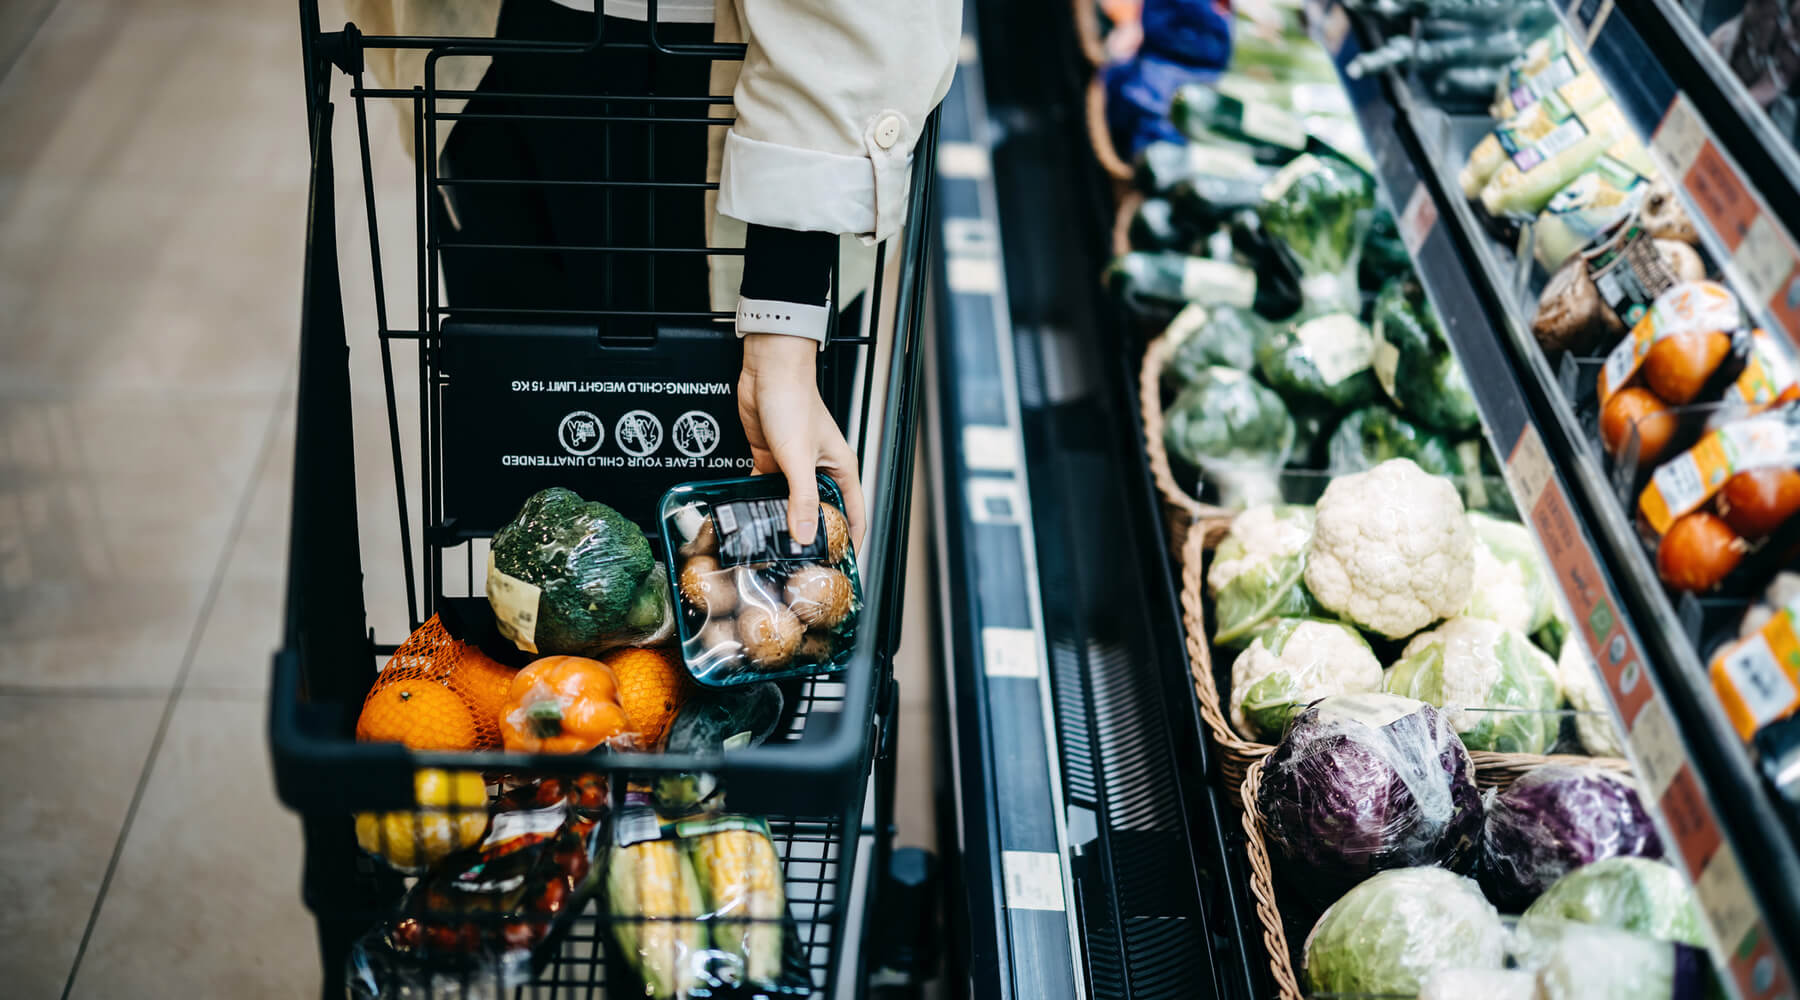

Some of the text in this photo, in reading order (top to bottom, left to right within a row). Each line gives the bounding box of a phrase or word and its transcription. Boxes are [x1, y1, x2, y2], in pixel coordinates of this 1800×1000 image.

[511, 381, 530, 391] KG
[532, 381, 545, 391] 15
[546, 381, 577, 392] LIMIT
[578, 381, 626, 392] WEIGHT
[502, 455, 754, 468] DO NOT LEAVE YOUR CHILD UNATTENDED
